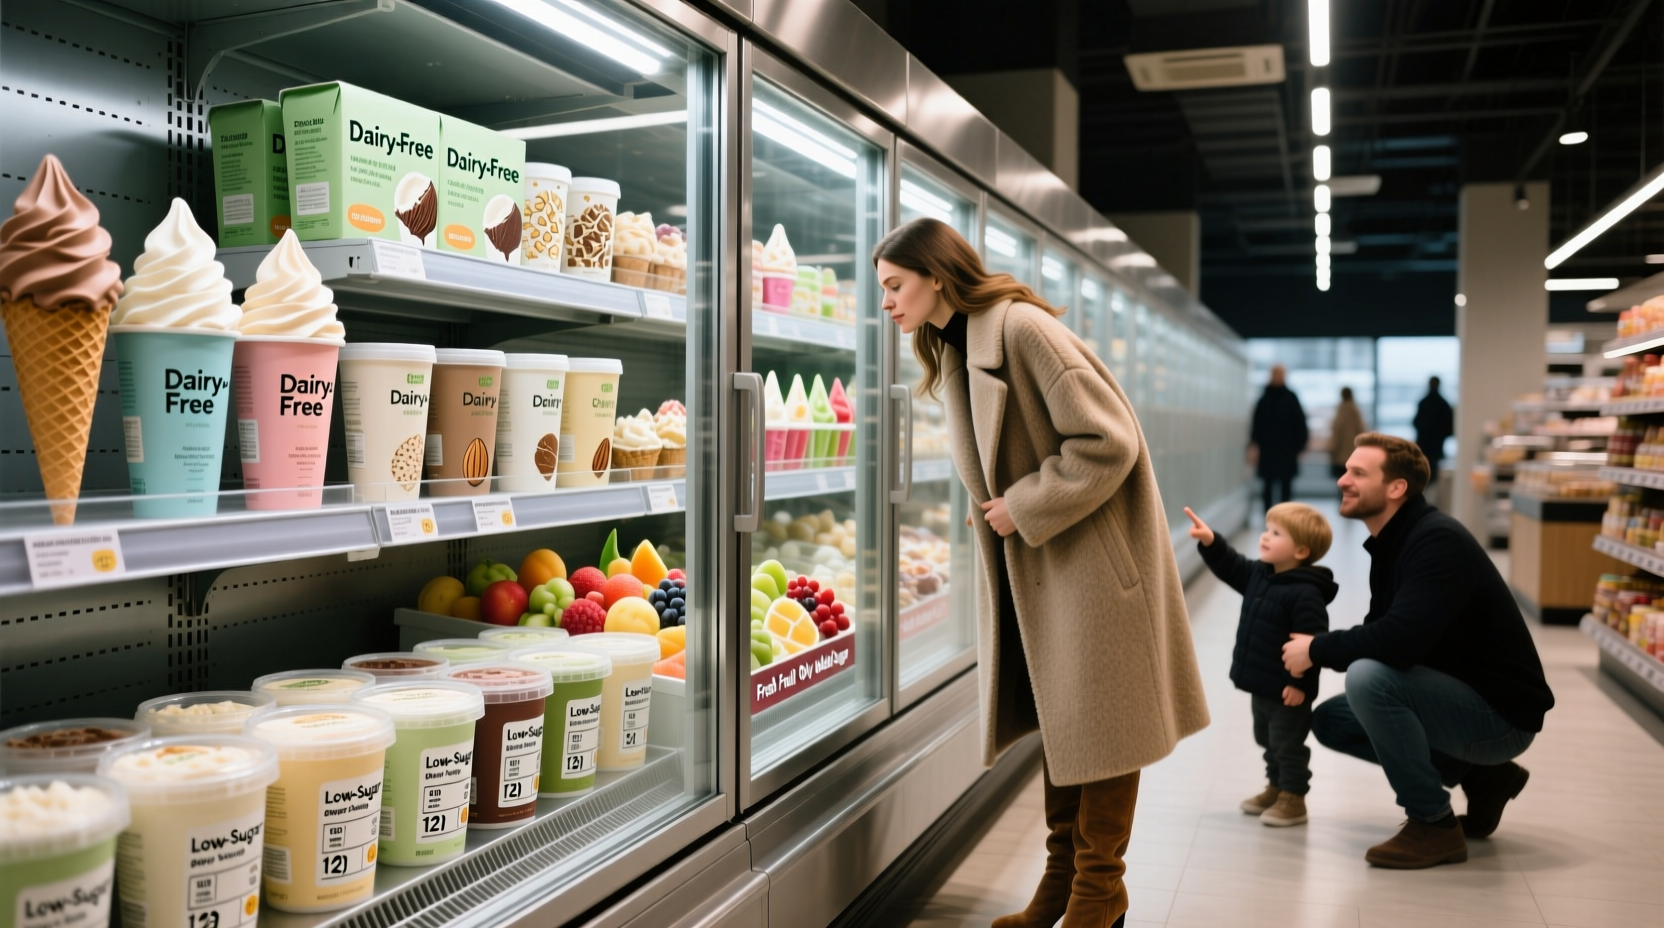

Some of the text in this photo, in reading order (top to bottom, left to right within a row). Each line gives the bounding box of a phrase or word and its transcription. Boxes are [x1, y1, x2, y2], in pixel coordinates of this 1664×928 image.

[349, 119, 434, 160] Dairy-Free
[447, 147, 520, 184] Dairy-Free
[166, 392, 214, 415] Free
[280, 395, 324, 417] Free
